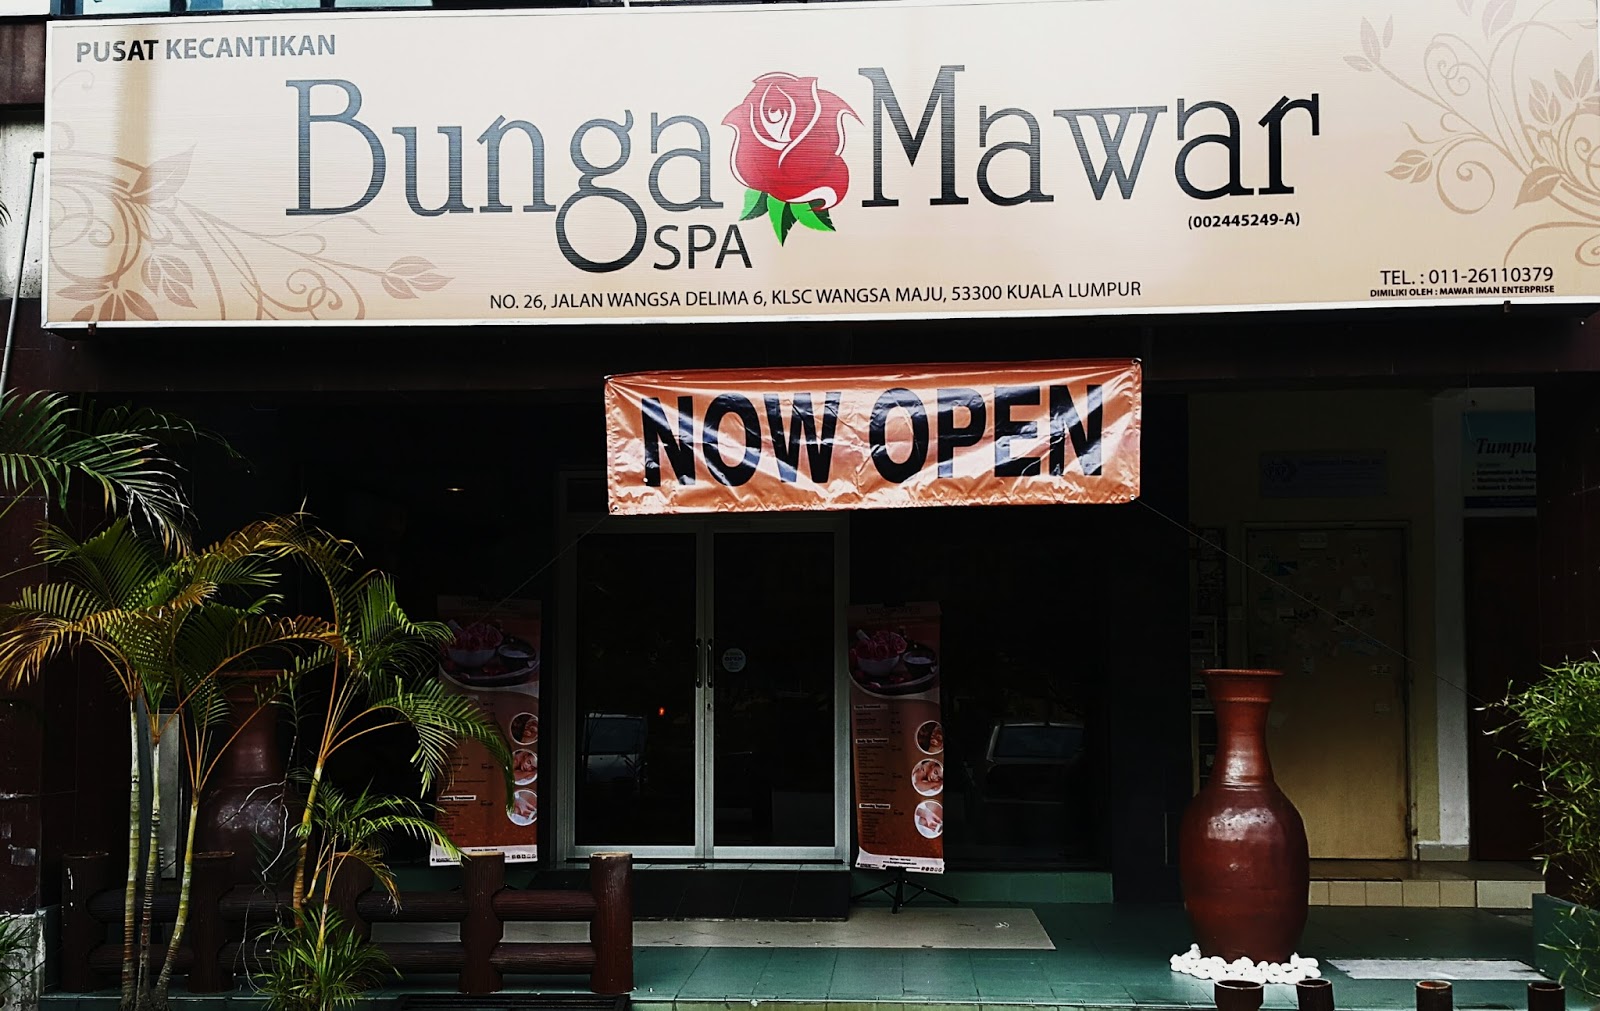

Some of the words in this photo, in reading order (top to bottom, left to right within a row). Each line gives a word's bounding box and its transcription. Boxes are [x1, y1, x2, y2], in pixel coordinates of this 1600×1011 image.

[76, 39, 159, 63] PUSAT
[165, 34, 336, 60] KECANTIKAN
[286, 79, 724, 273] Bunga
[858, 64, 1321, 207] Mawar
[1188, 211, 1301, 230] (002445249-A)
[652, 224, 753, 271] SPA
[1380, 270, 1416, 286] TEL.
[1428, 267, 1554, 284] 011-26110379
[489, 294, 519, 309] NO.
[523, 294, 547, 311] 26,
[551, 293, 604, 309] JALAN
[607, 291, 681, 308] WANGSA
[685, 290, 749, 306] DELIMA
[753, 290, 768, 308] 6,
[772, 289, 813, 305] KLSC
[816, 288, 891, 304] WANGSA
[895, 286, 947, 303] MAJU,
[951, 285, 1002, 301] 53300
[1006, 284, 1064, 300] KUALA
[1068, 281, 1142, 298] LUMPUR
[1370, 288, 1408, 298] DIMILIKI
[1409, 288, 1433, 297] OLEH
[1439, 286, 1474, 296] MAWAR
[1475, 286, 1500, 295] IMAN
[1501, 285, 1555, 295] ENTERPRISE
[640, 390, 842, 488] NOW
[868, 384, 1104, 484] OPEN
